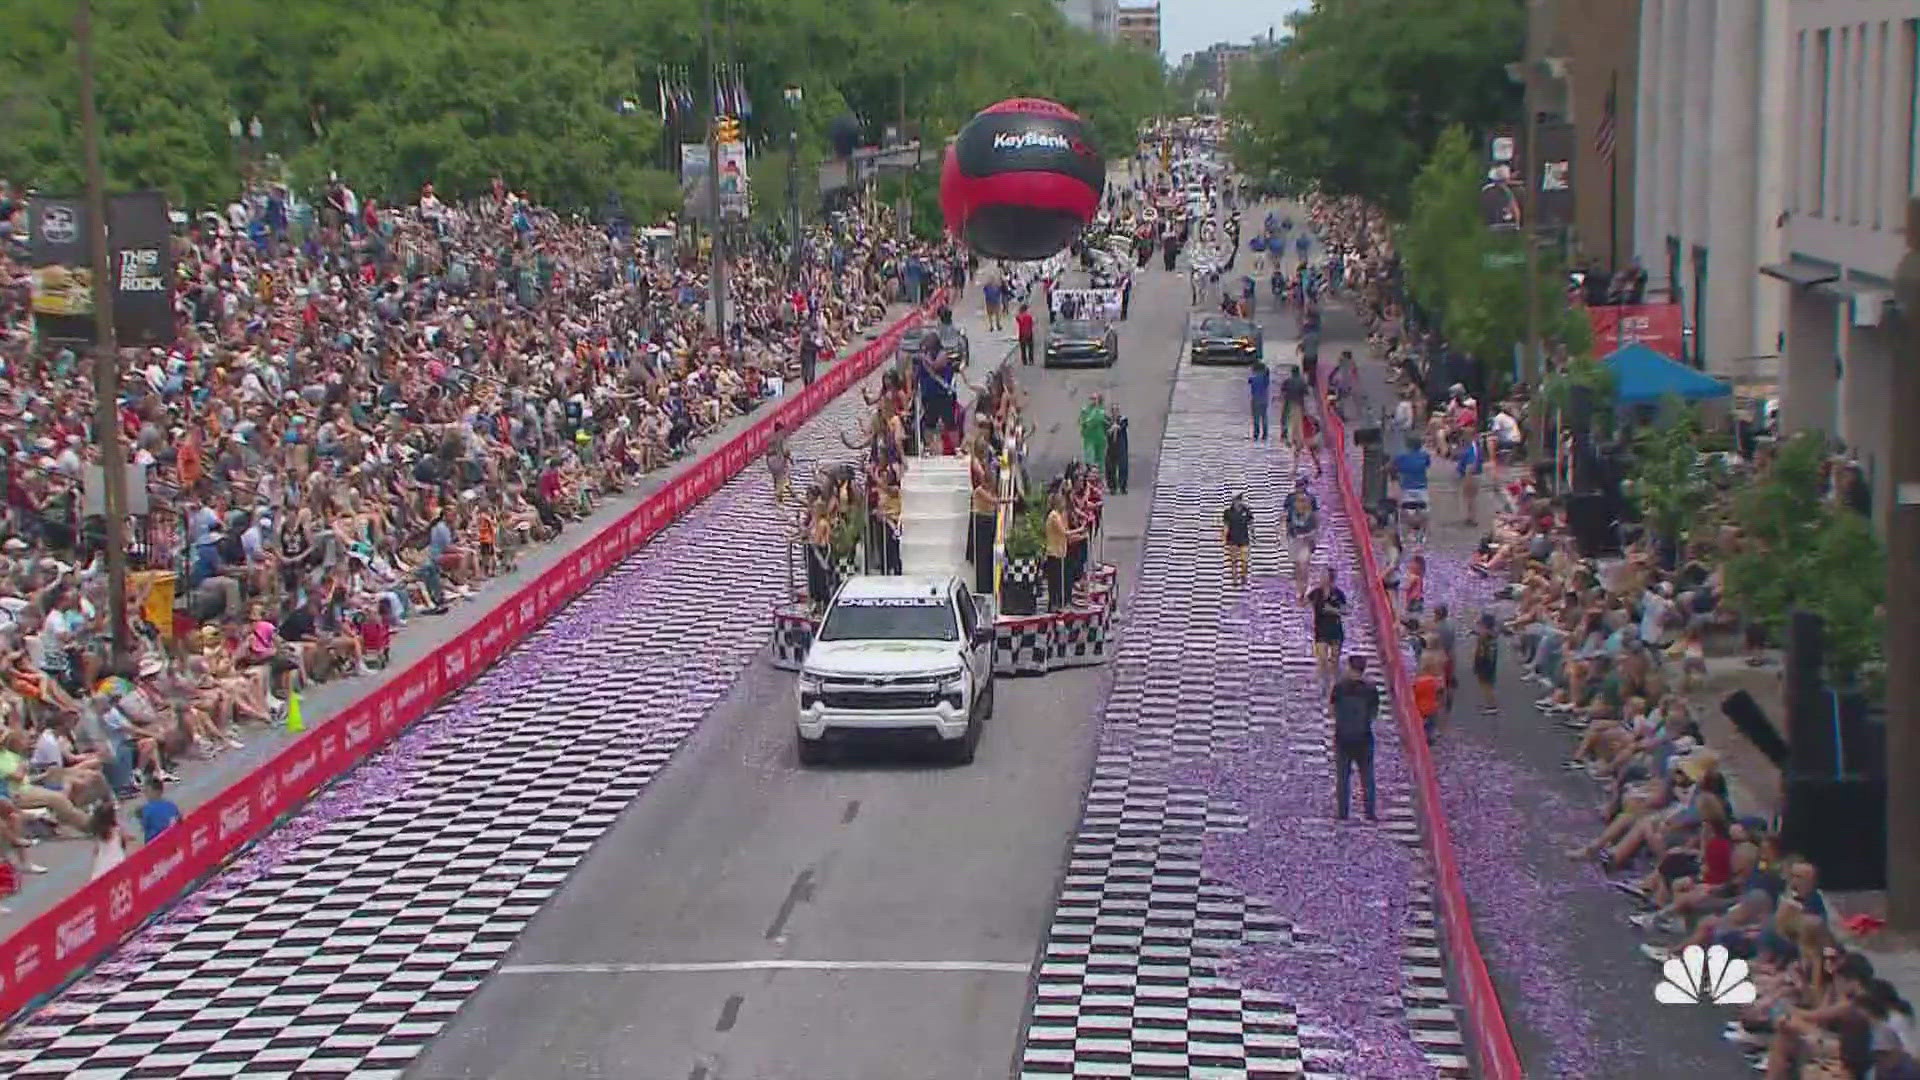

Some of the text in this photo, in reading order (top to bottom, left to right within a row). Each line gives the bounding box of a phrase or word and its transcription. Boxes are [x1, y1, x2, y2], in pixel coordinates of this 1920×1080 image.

[993, 131, 1070, 149] KeyBank
[119, 250, 158, 265] THIS
[119, 277, 166, 291] ROCK
